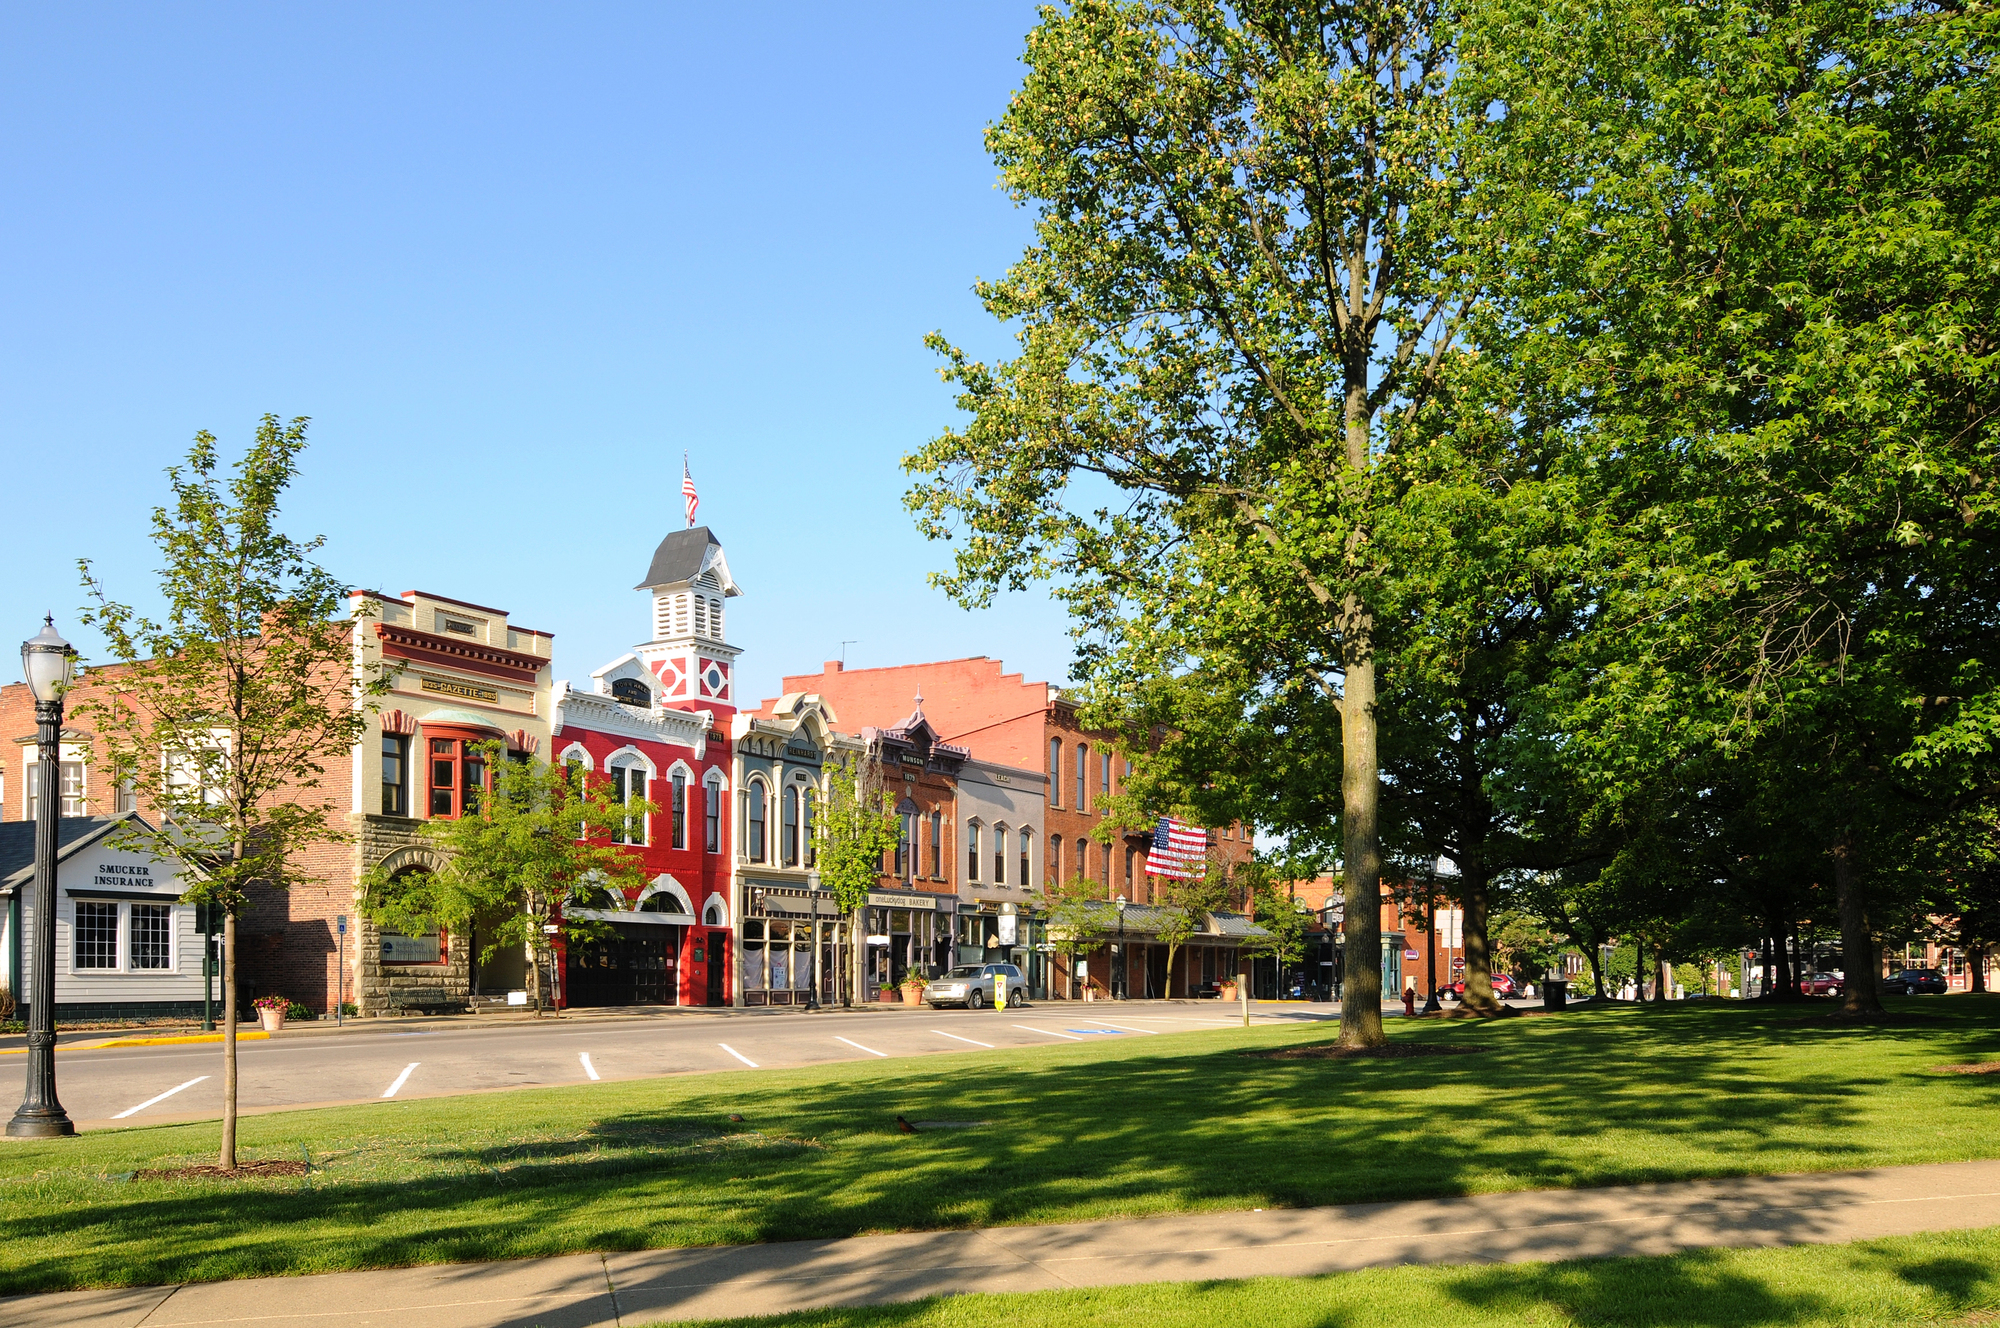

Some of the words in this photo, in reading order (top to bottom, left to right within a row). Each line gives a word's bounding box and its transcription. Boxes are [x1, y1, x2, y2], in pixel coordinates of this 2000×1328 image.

[788, 746, 818, 759] REINHARDT
[902, 754, 924, 766] MUNSON
[904, 773, 916, 782] 1879
[99, 864, 149, 876] SMUCKER
[94, 875, 154, 887] INSURANCE
[909, 898, 930, 907] BAKERY
